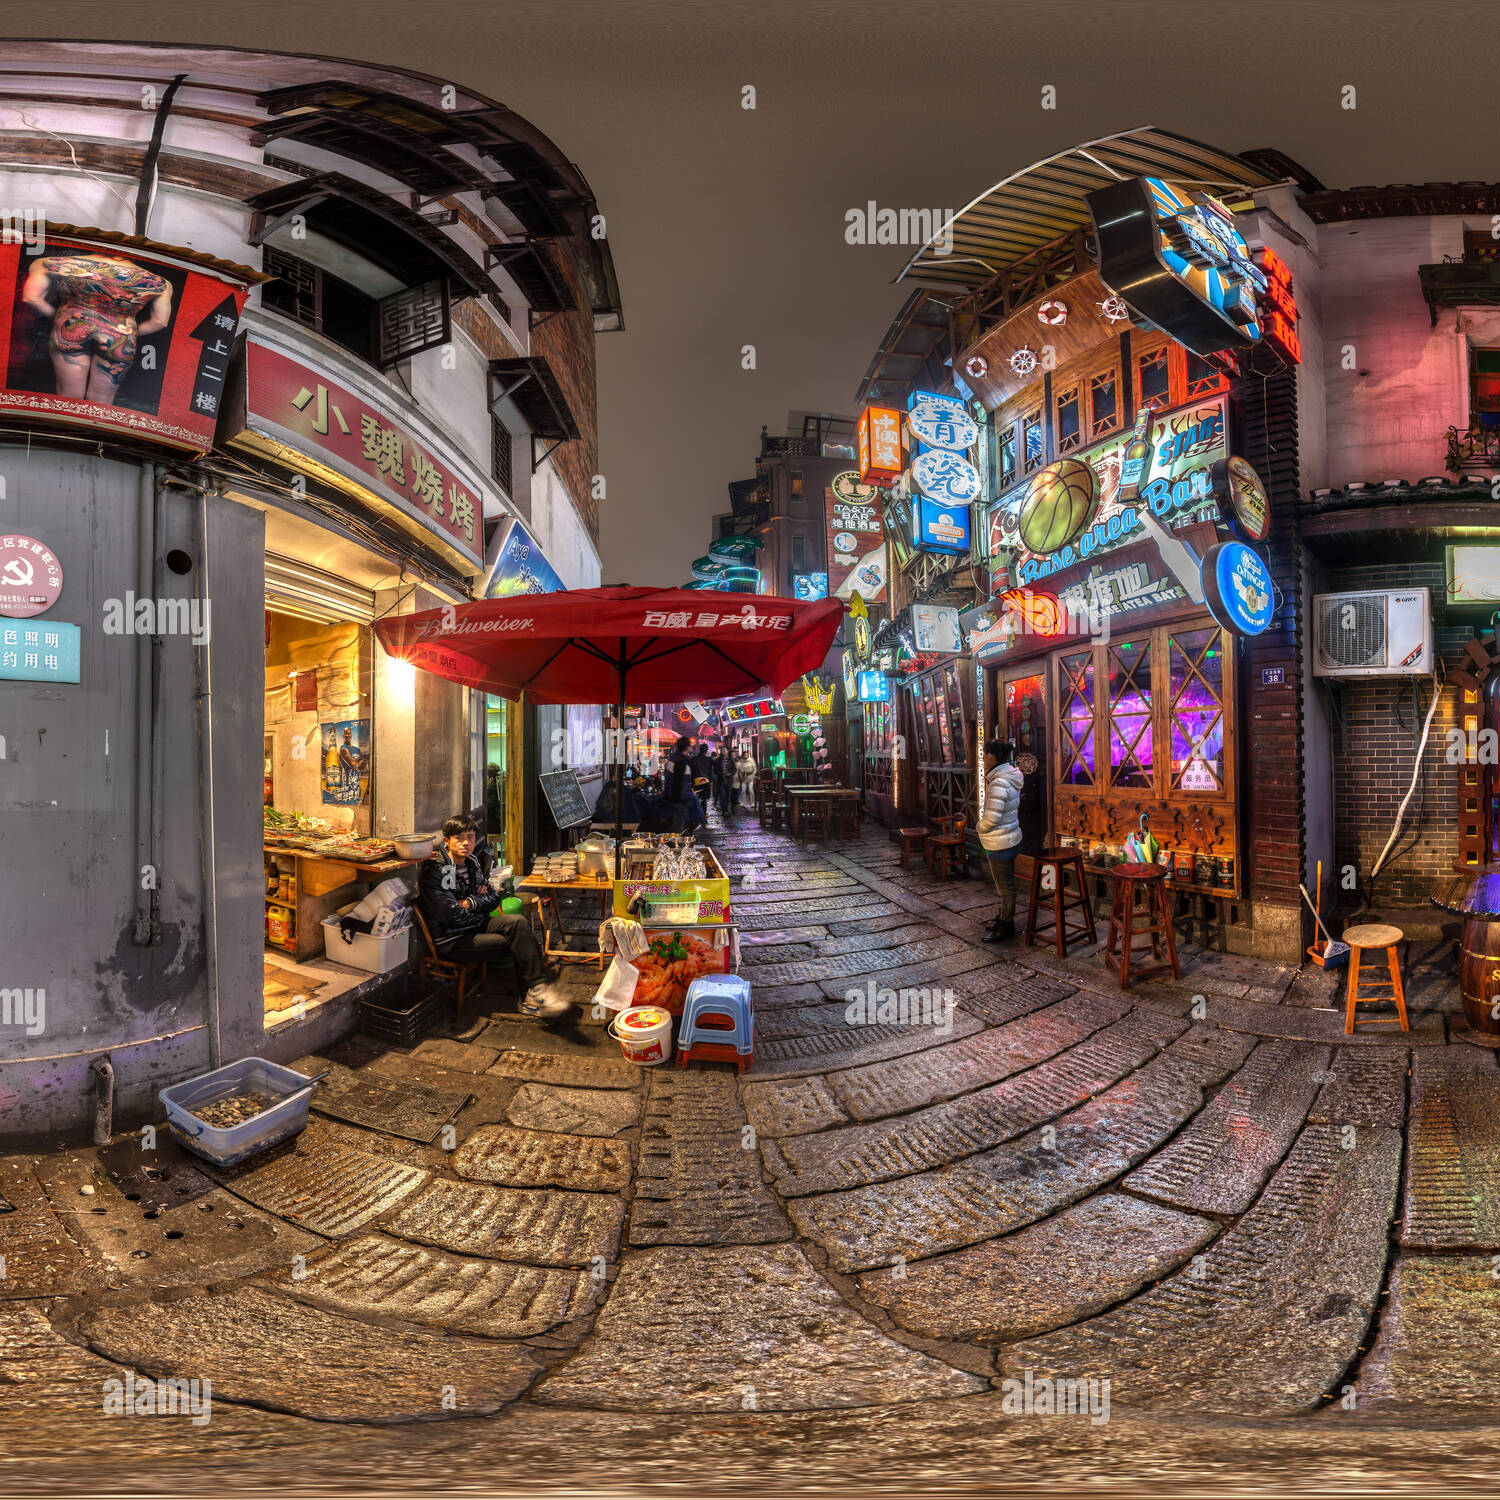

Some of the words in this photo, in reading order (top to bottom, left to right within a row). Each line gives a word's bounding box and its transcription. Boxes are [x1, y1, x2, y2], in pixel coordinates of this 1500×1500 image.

[195, 313, 236, 413] 请上二楼
[291, 384, 475, 542] 小魏烧烤
[842, 512, 869, 521] BAR
[1021, 546, 1076, 586] Base
[1080, 508, 1141, 557] area
[1141, 468, 1213, 517] Bar
[507, 535, 529, 561] Aya
[4, 630, 59, 649] 色照明
[3, 651, 59, 670] 约用电
[1268, 674, 1279, 683] 38
